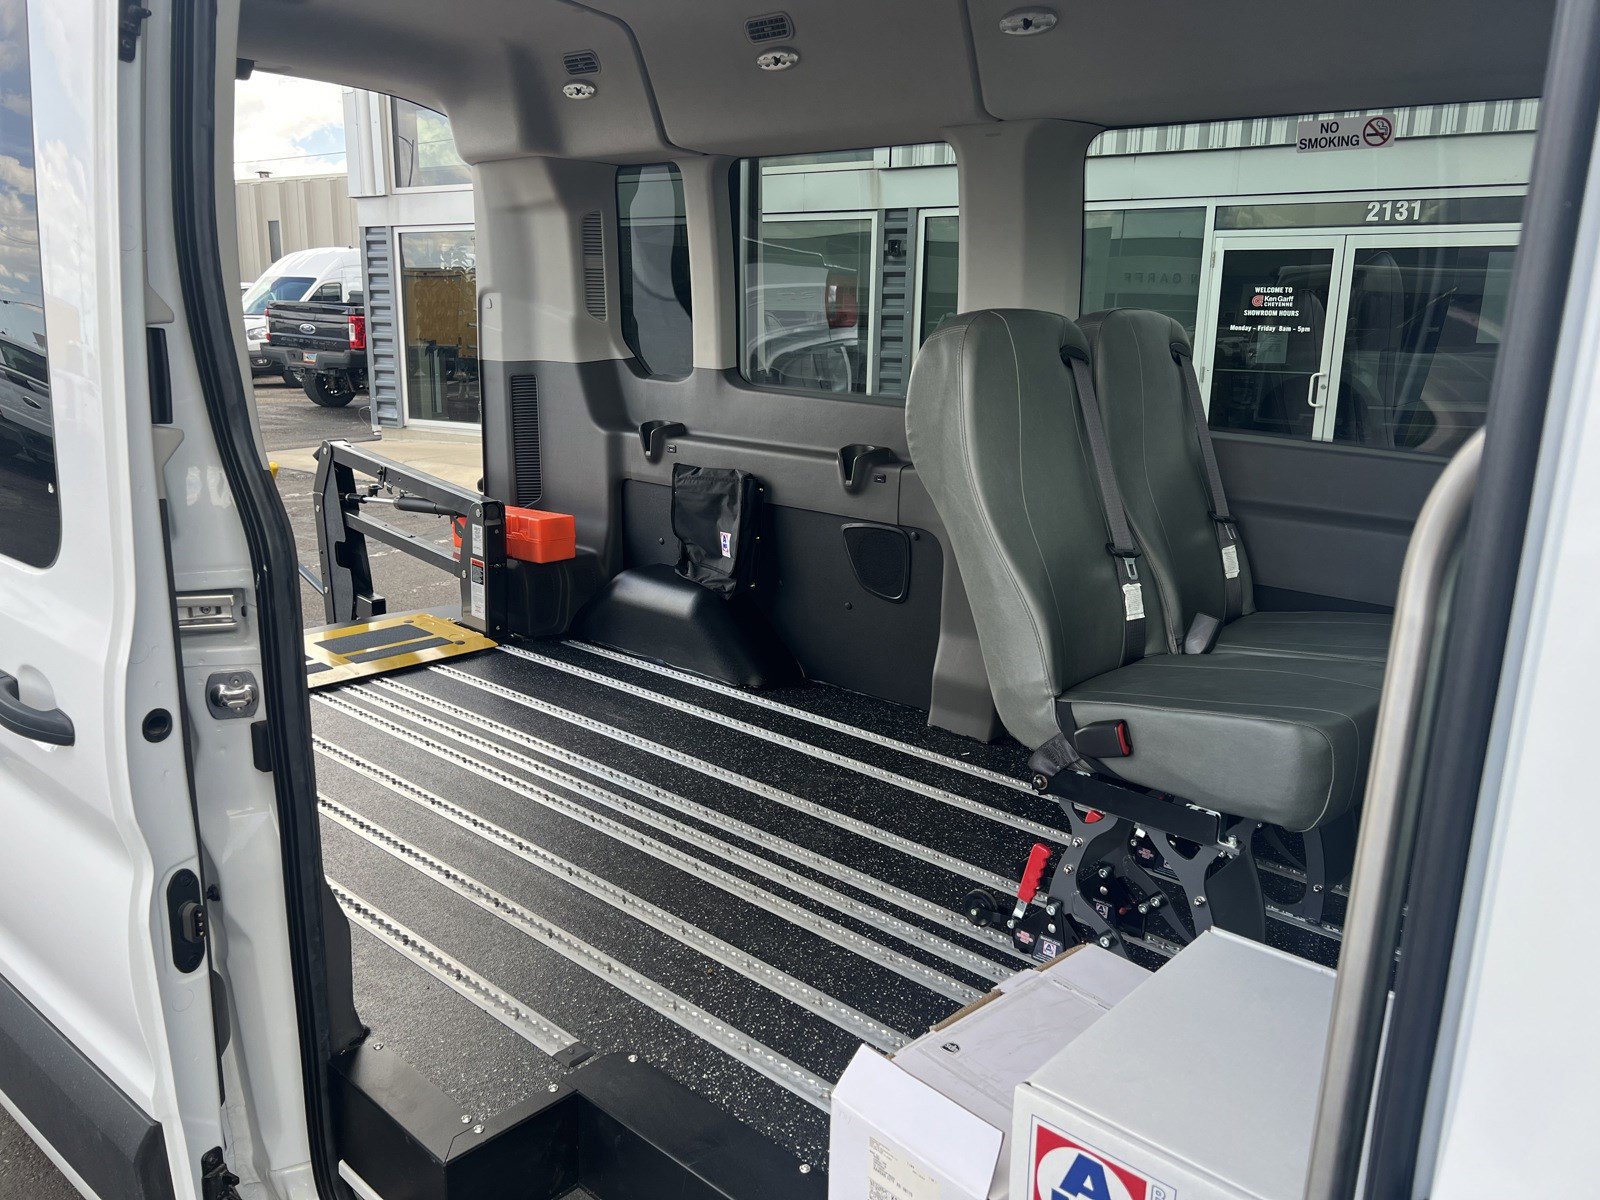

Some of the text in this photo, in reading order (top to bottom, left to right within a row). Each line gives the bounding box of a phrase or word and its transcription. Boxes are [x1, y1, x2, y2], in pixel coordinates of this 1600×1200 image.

[1320, 121, 1339, 134] NO
[1299, 134, 1360, 150] SMOKING
[1365, 199, 1421, 222] 2131
[1257, 325, 1276, 333] Friday
